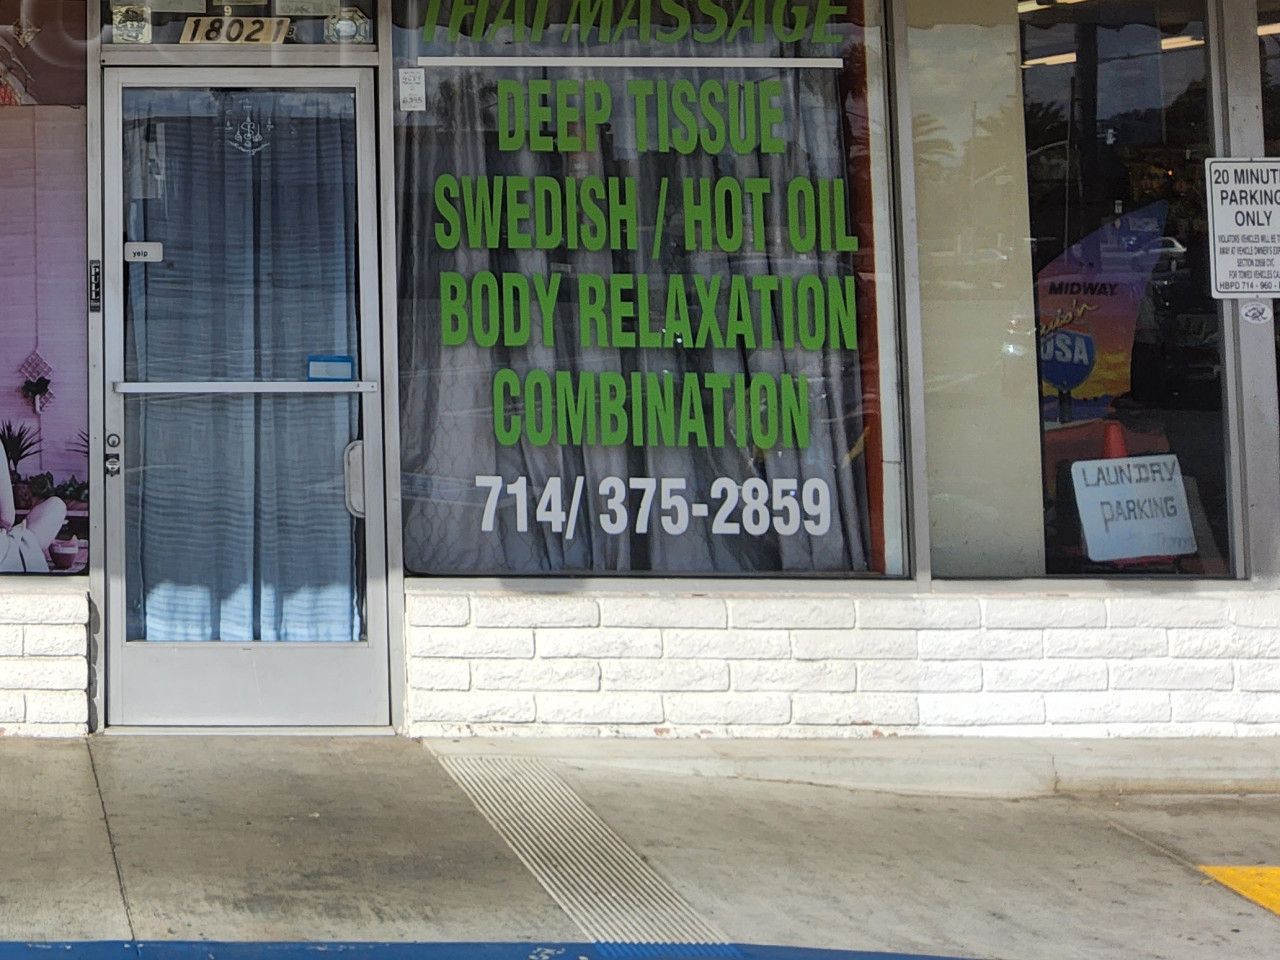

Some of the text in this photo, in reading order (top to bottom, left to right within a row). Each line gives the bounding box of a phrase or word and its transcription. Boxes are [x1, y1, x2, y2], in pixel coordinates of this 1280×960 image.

[189, 17, 286, 43] 18021
[497, 79, 787, 155] DEEP TISSUE
[1214, 169, 1280, 185] 20 MINUT
[1220, 190, 1280, 206] PARKING
[433, 173, 859, 261] SWEDISH / HOT OIL
[1235, 210, 1273, 227] ONLY
[132, 250, 149, 258] yelp
[1049, 282, 1120, 296] MIDWAY
[438, 270, 859, 351] BODY RELAXATION
[1040, 333, 1090, 366] USA
[492, 368, 811, 450] COMBINATION
[1082, 461, 1177, 487] LAUNDRY
[475, 475, 831, 540] 714/ 375-2859
